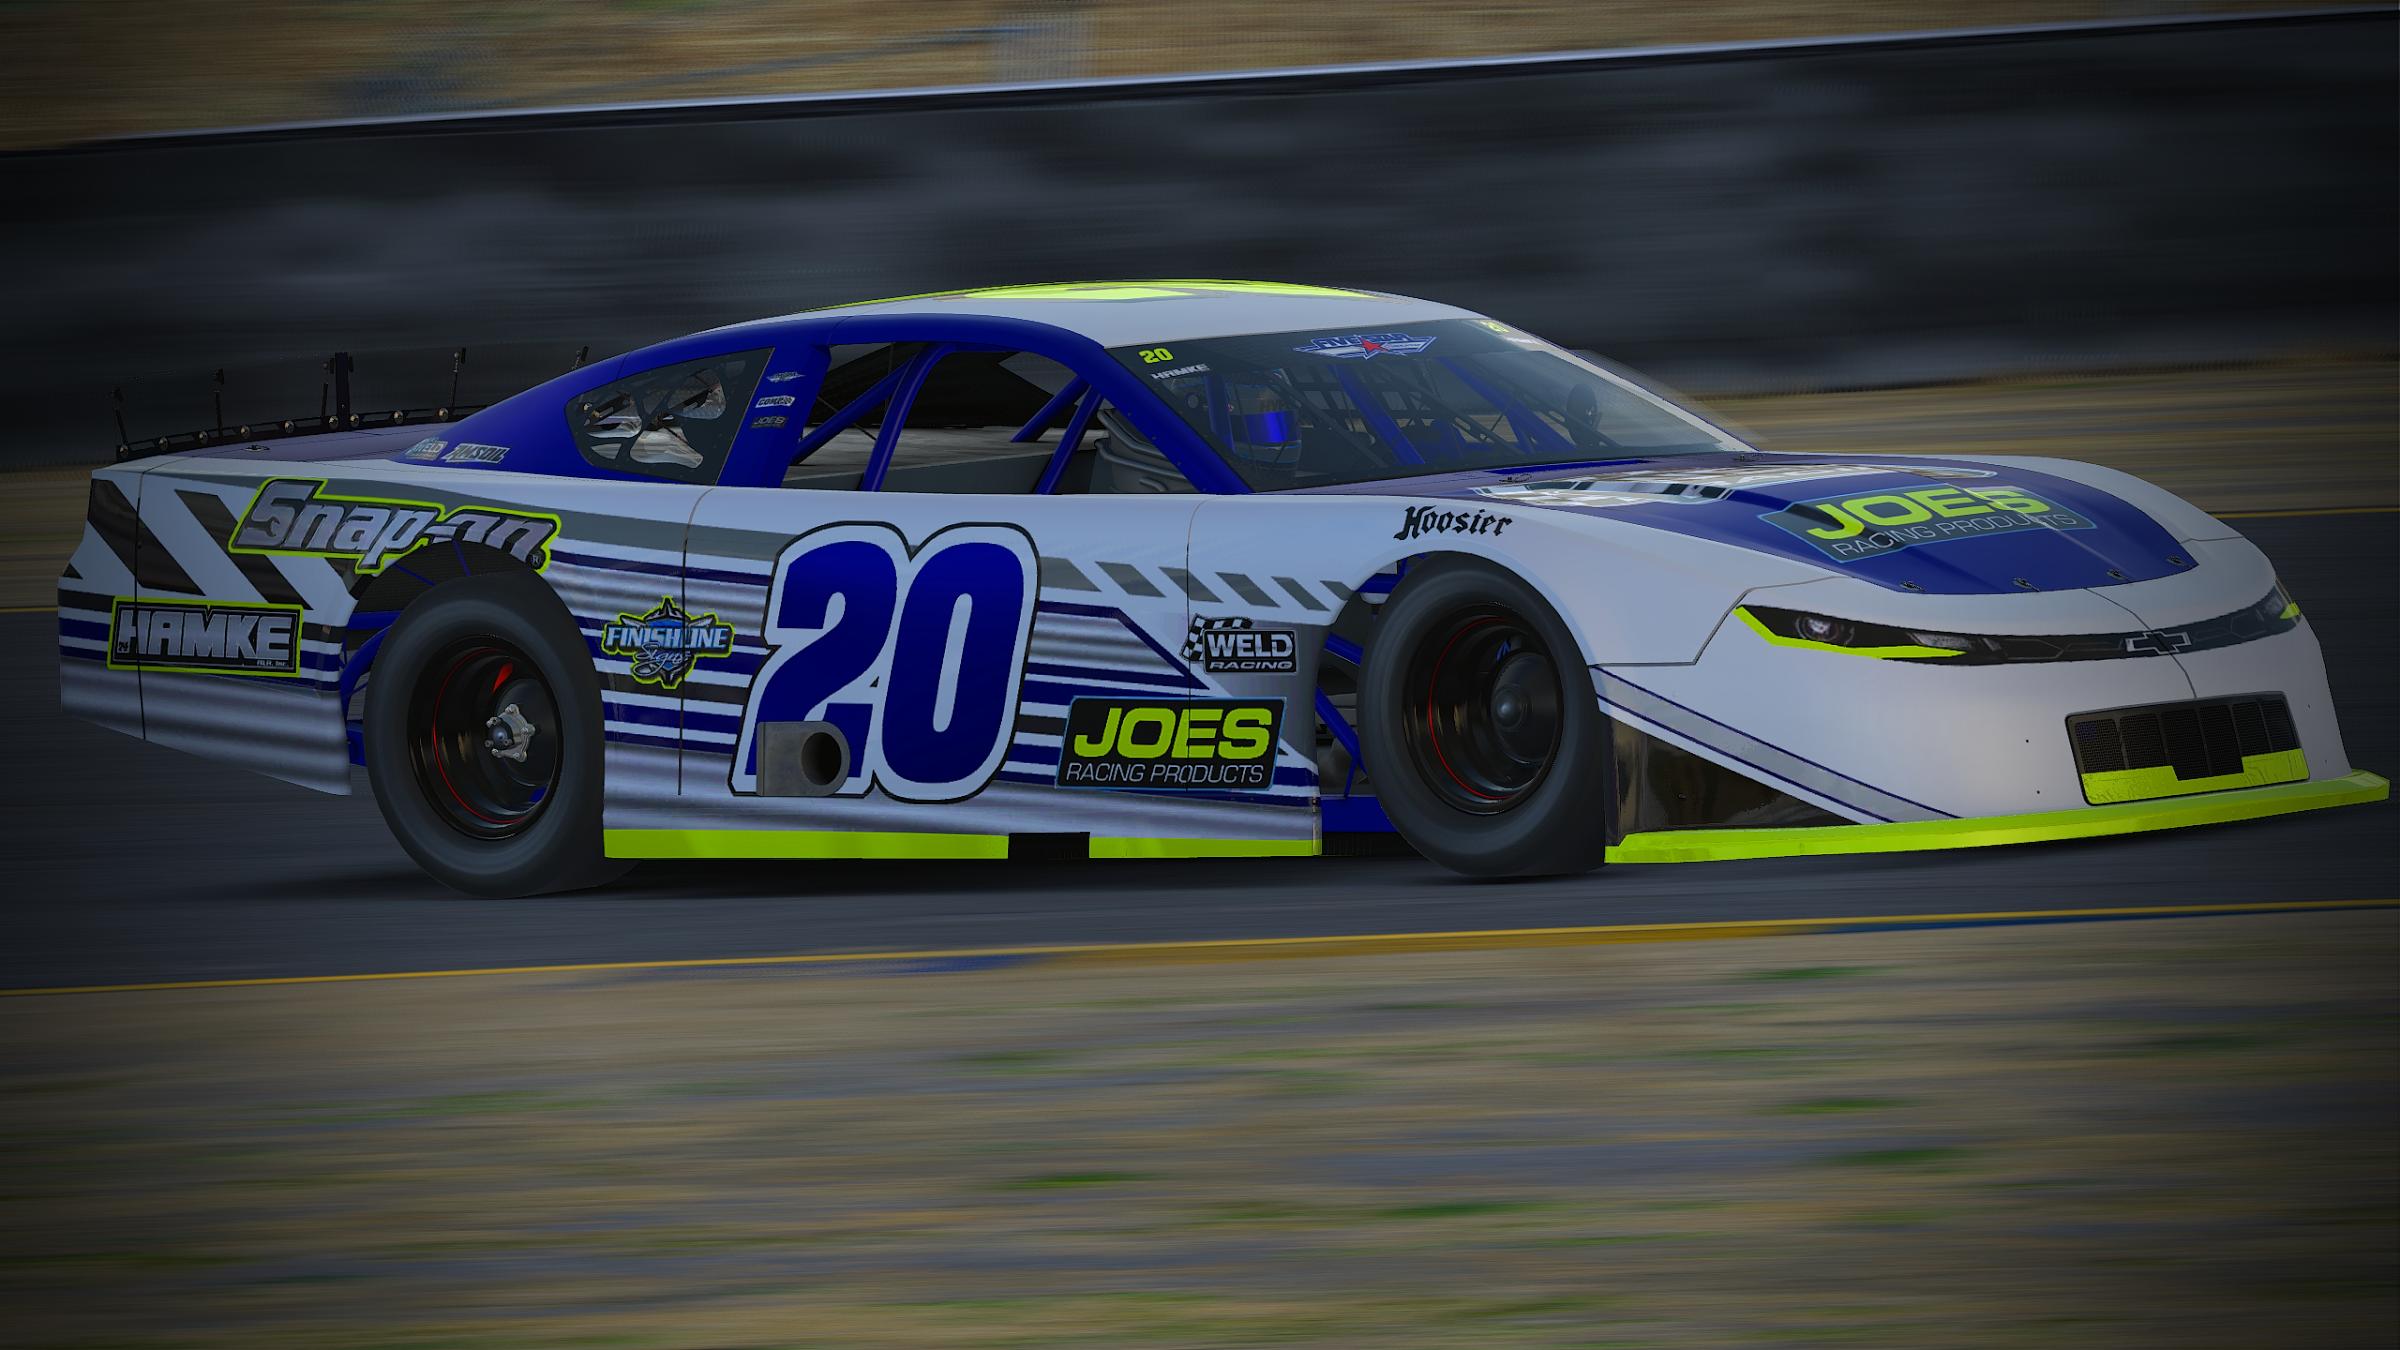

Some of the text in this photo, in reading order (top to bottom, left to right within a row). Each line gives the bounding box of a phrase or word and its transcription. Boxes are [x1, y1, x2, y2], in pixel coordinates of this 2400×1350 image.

[1138, 347, 1175, 364] 20
[1150, 363, 1211, 380] HAMKE
[1393, 505, 1512, 541] Hoosier
[1806, 488, 2050, 540] JOES
[1831, 512, 2078, 556] RACING PRODUCTS
[117, 609, 293, 662] HAMKE
[1207, 633, 1293, 657] WELD
[740, 536, 1028, 787] 20
[1209, 660, 1293, 670] RACING
[1073, 707, 1273, 759] JOES
[1065, 763, 1264, 784] RACING PRODUCTS
